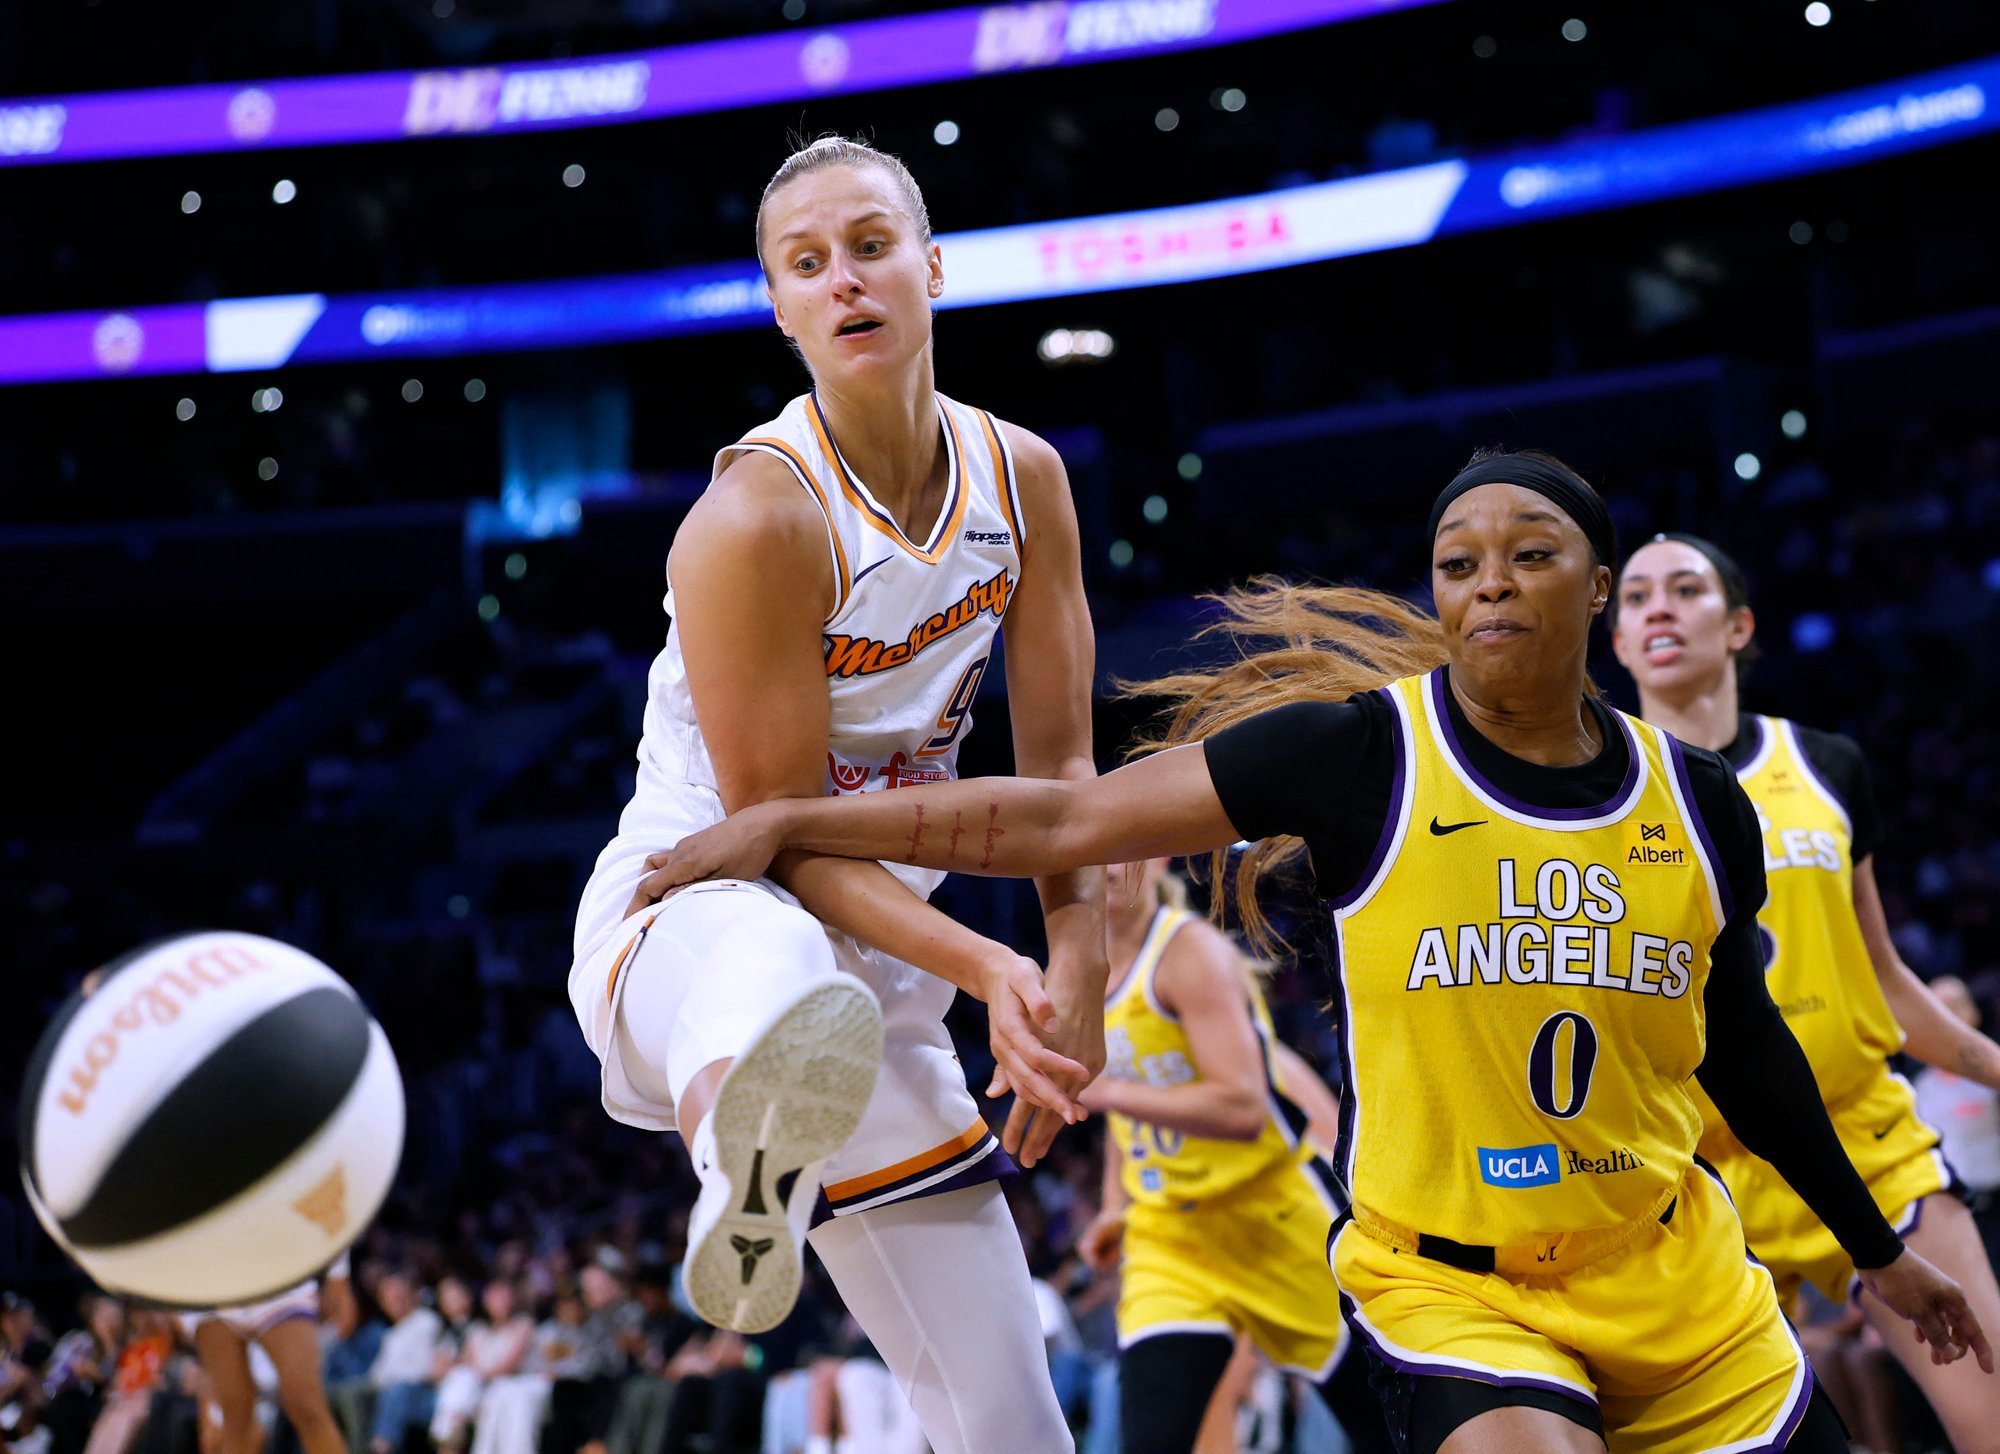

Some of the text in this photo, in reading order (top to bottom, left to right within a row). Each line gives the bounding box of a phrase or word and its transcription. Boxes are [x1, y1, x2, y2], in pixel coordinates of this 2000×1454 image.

[825, 566, 1014, 678] Mercury
[914, 654, 988, 758] 9
[1498, 858, 1626, 923] LOS
[1627, 845, 1685, 864] Albert
[1406, 922, 1694, 999] ANGELES
[57, 943, 273, 1117] Wilson
[1527, 1010, 1599, 1120] 0
[1488, 1146, 1645, 1180] UCLA Health
